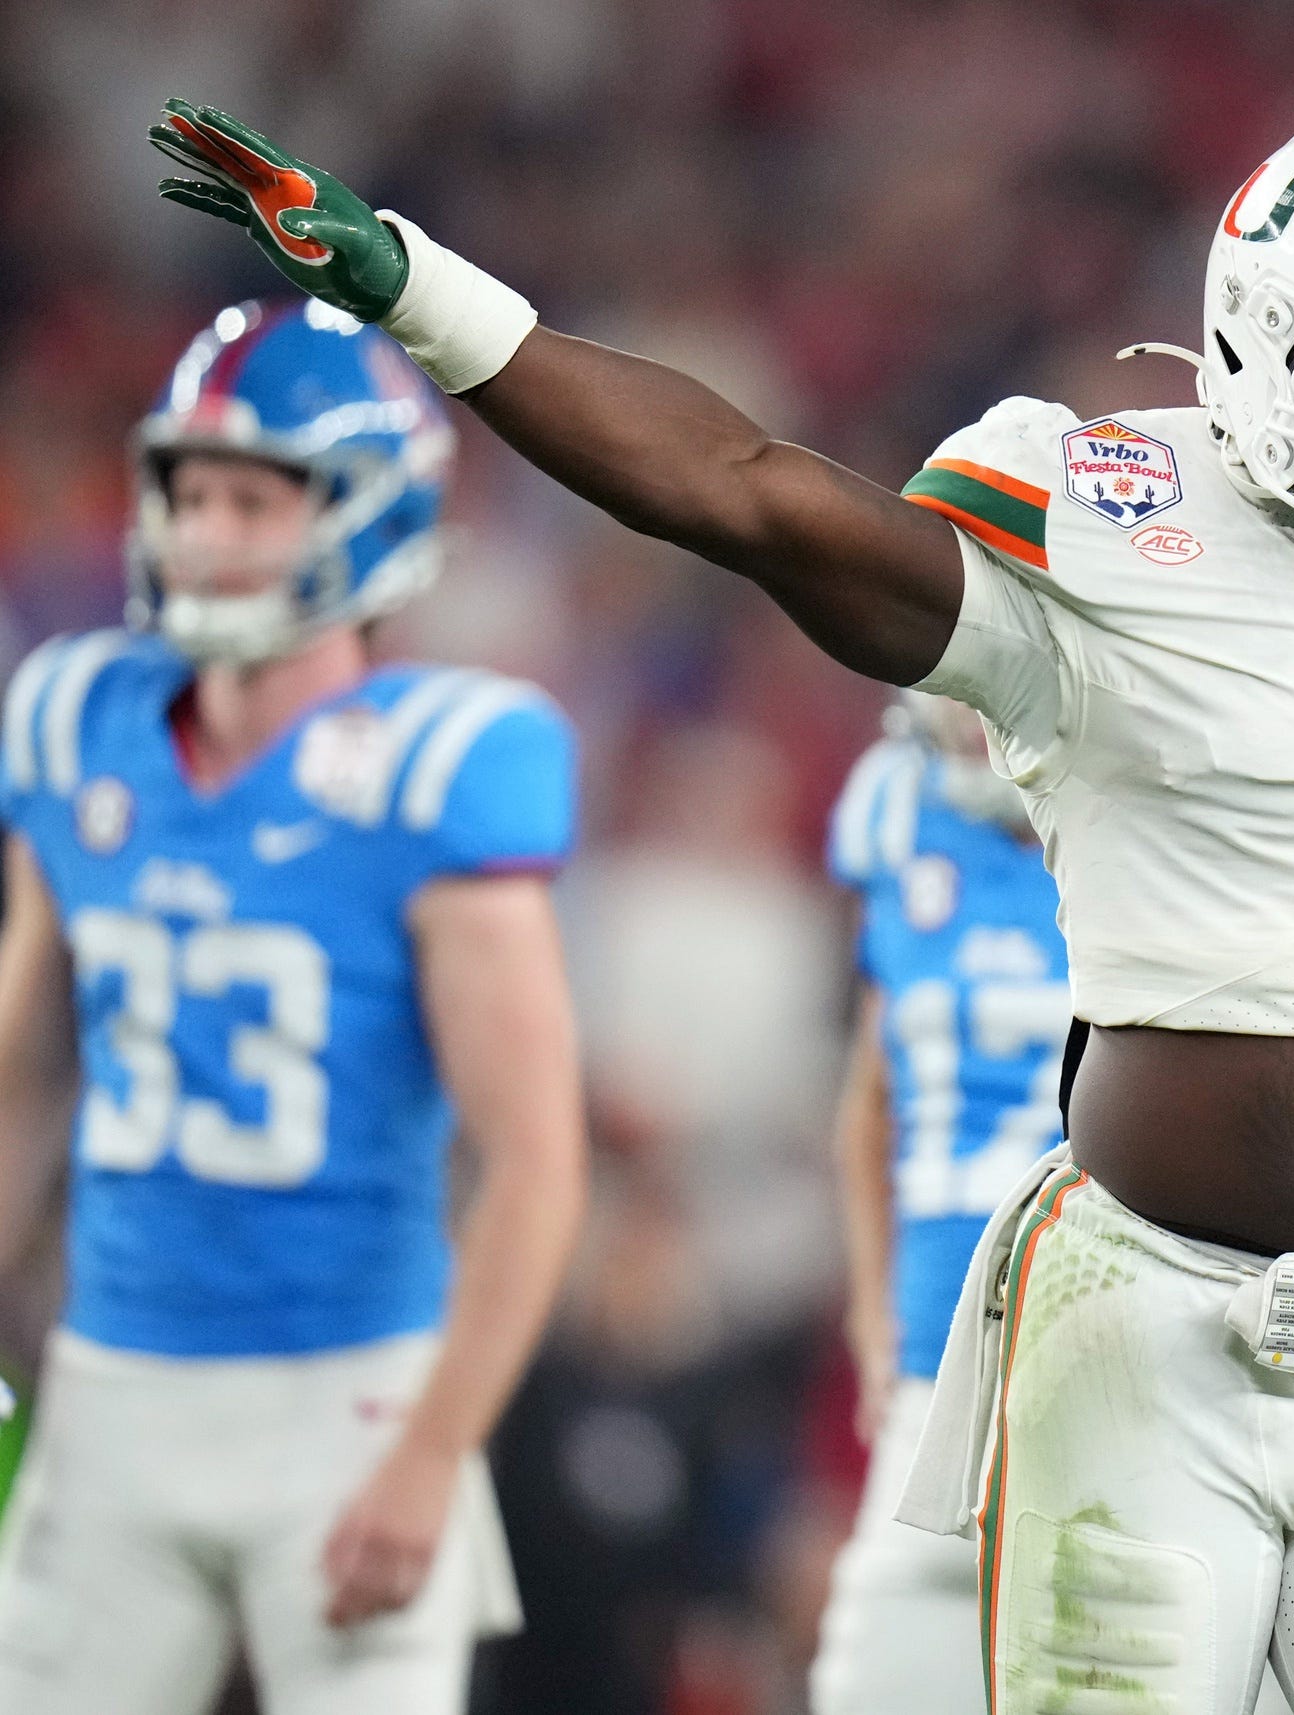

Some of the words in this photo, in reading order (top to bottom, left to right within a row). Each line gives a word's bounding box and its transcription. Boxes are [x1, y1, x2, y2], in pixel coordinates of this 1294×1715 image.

[1087, 441, 1149, 462] Vrbo
[1069, 460, 1122, 475] Fiesta
[1124, 462, 1174, 483] Bowl
[1141, 534, 1194, 552] ACC
[70, 905, 332, 1188] 33
